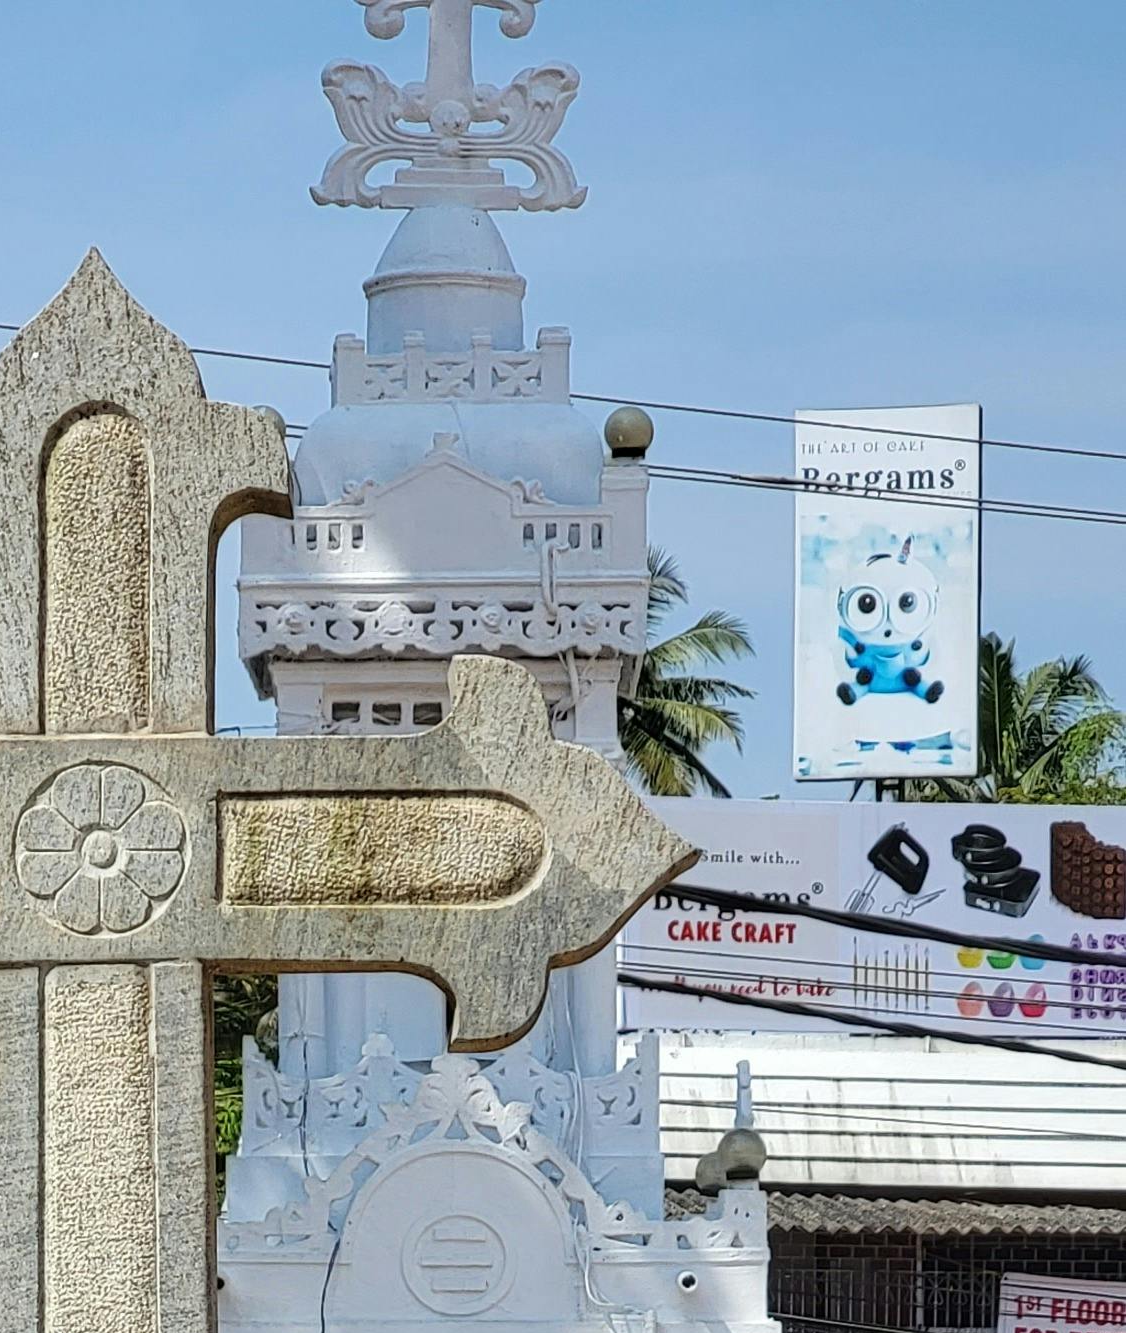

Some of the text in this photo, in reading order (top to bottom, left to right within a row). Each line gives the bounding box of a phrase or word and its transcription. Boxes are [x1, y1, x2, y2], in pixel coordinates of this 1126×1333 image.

[831, 441, 856, 454] ART
[667, 920, 797, 944] CAKE CRAFT
[773, 976, 792, 997] to
[1051, 1298, 1126, 1326] FLOOR
